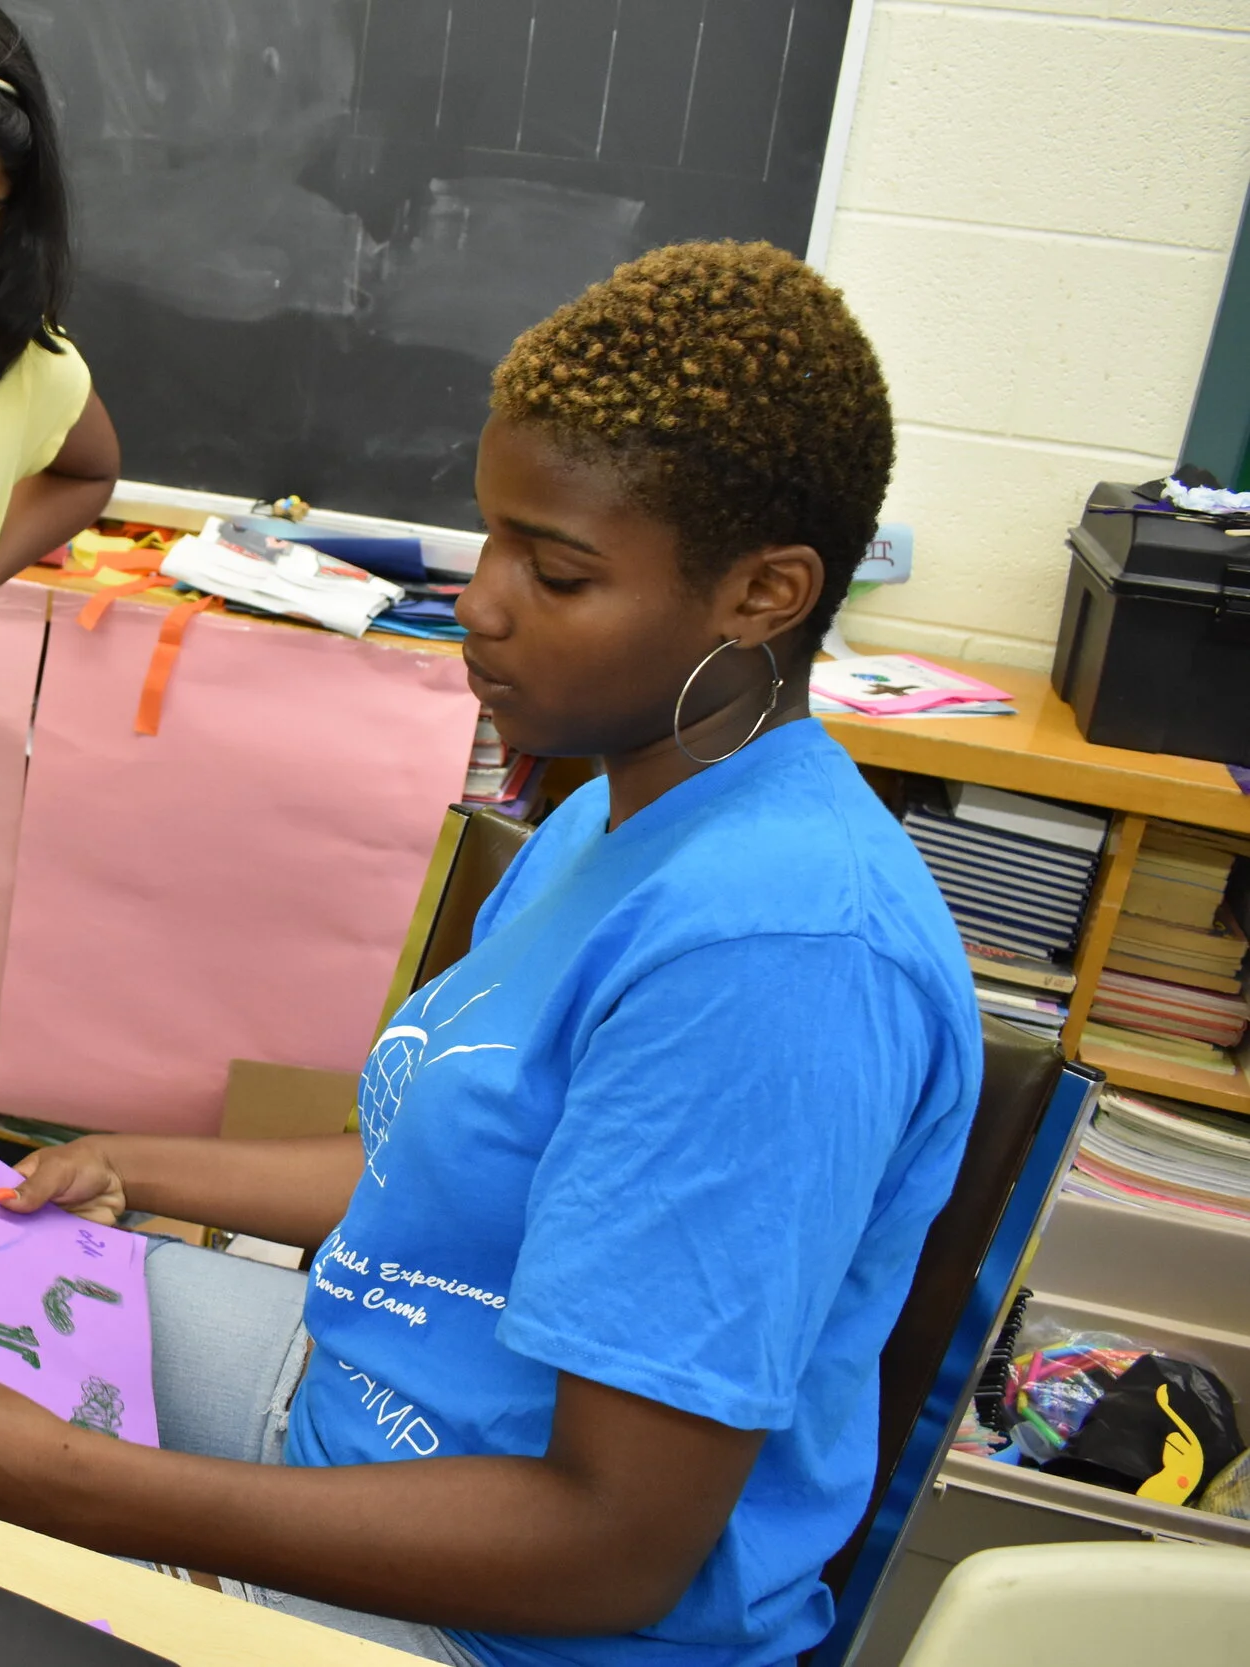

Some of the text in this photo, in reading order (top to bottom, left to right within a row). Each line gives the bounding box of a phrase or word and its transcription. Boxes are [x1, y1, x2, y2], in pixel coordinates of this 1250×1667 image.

[362, 1287, 427, 1327] Camp
[379, 1263, 507, 1310] Experience
[338, 1360, 440, 1456] AMP
